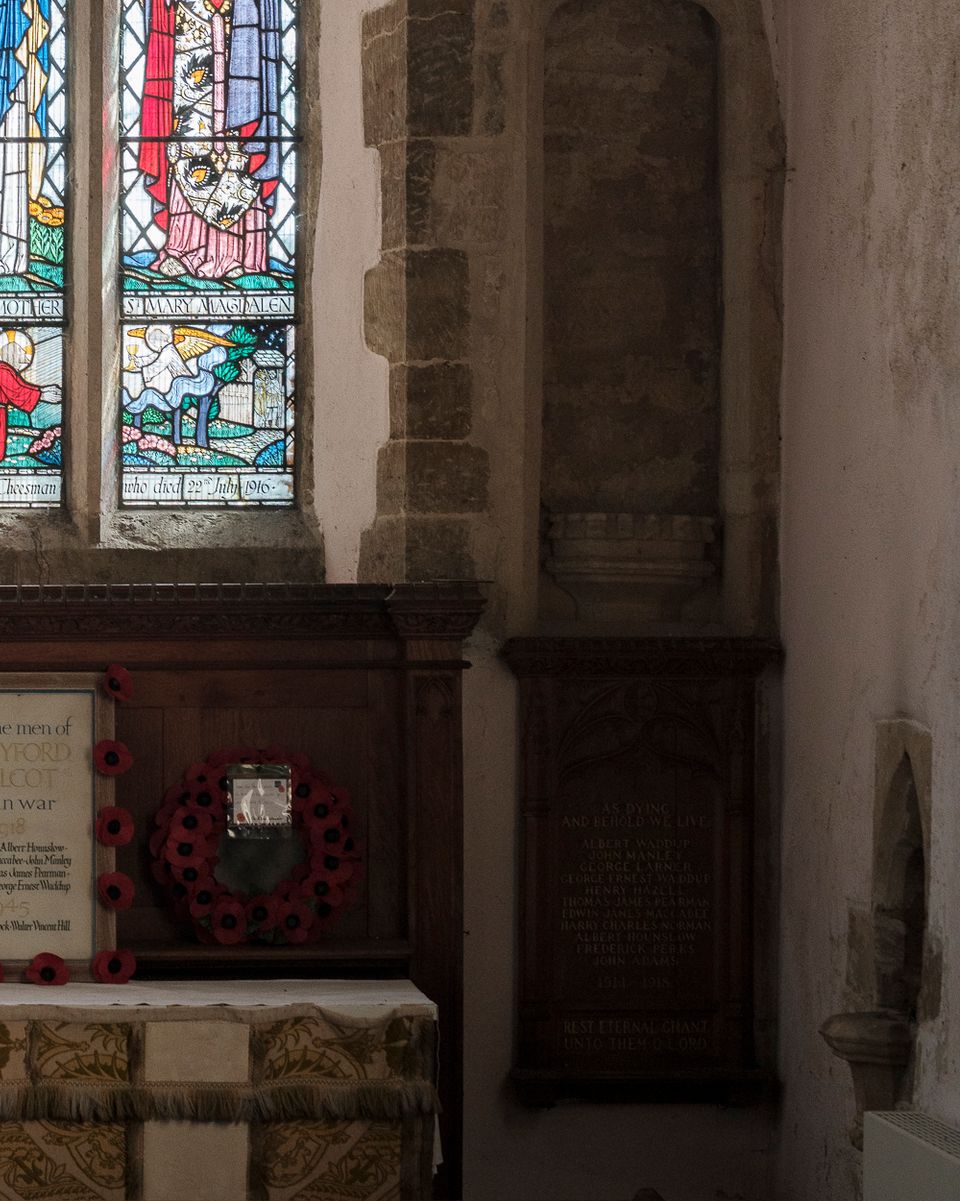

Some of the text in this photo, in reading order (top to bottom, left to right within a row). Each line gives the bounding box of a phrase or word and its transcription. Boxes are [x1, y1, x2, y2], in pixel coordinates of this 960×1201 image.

[145, 298, 192, 313] MARY
[197, 298, 291, 314] MAGDALEN
[124, 476, 148, 494] who
[153, 476, 182, 494] died
[207, 478, 238, 499] July
[17, 722, 52, 735] men
[55, 715, 73, 736] of
[18, 798, 57, 810] war
[561, 815, 591, 827] AND
[593, 815, 645, 827] BEHOLD
[589, 850, 622, 860] JOHN
[563, 1020, 594, 1034] REST
[599, 1020, 658, 1034] ETERNAL
[564, 1037, 602, 1050] UNTO
[608, 1037, 647, 1050] THEM
